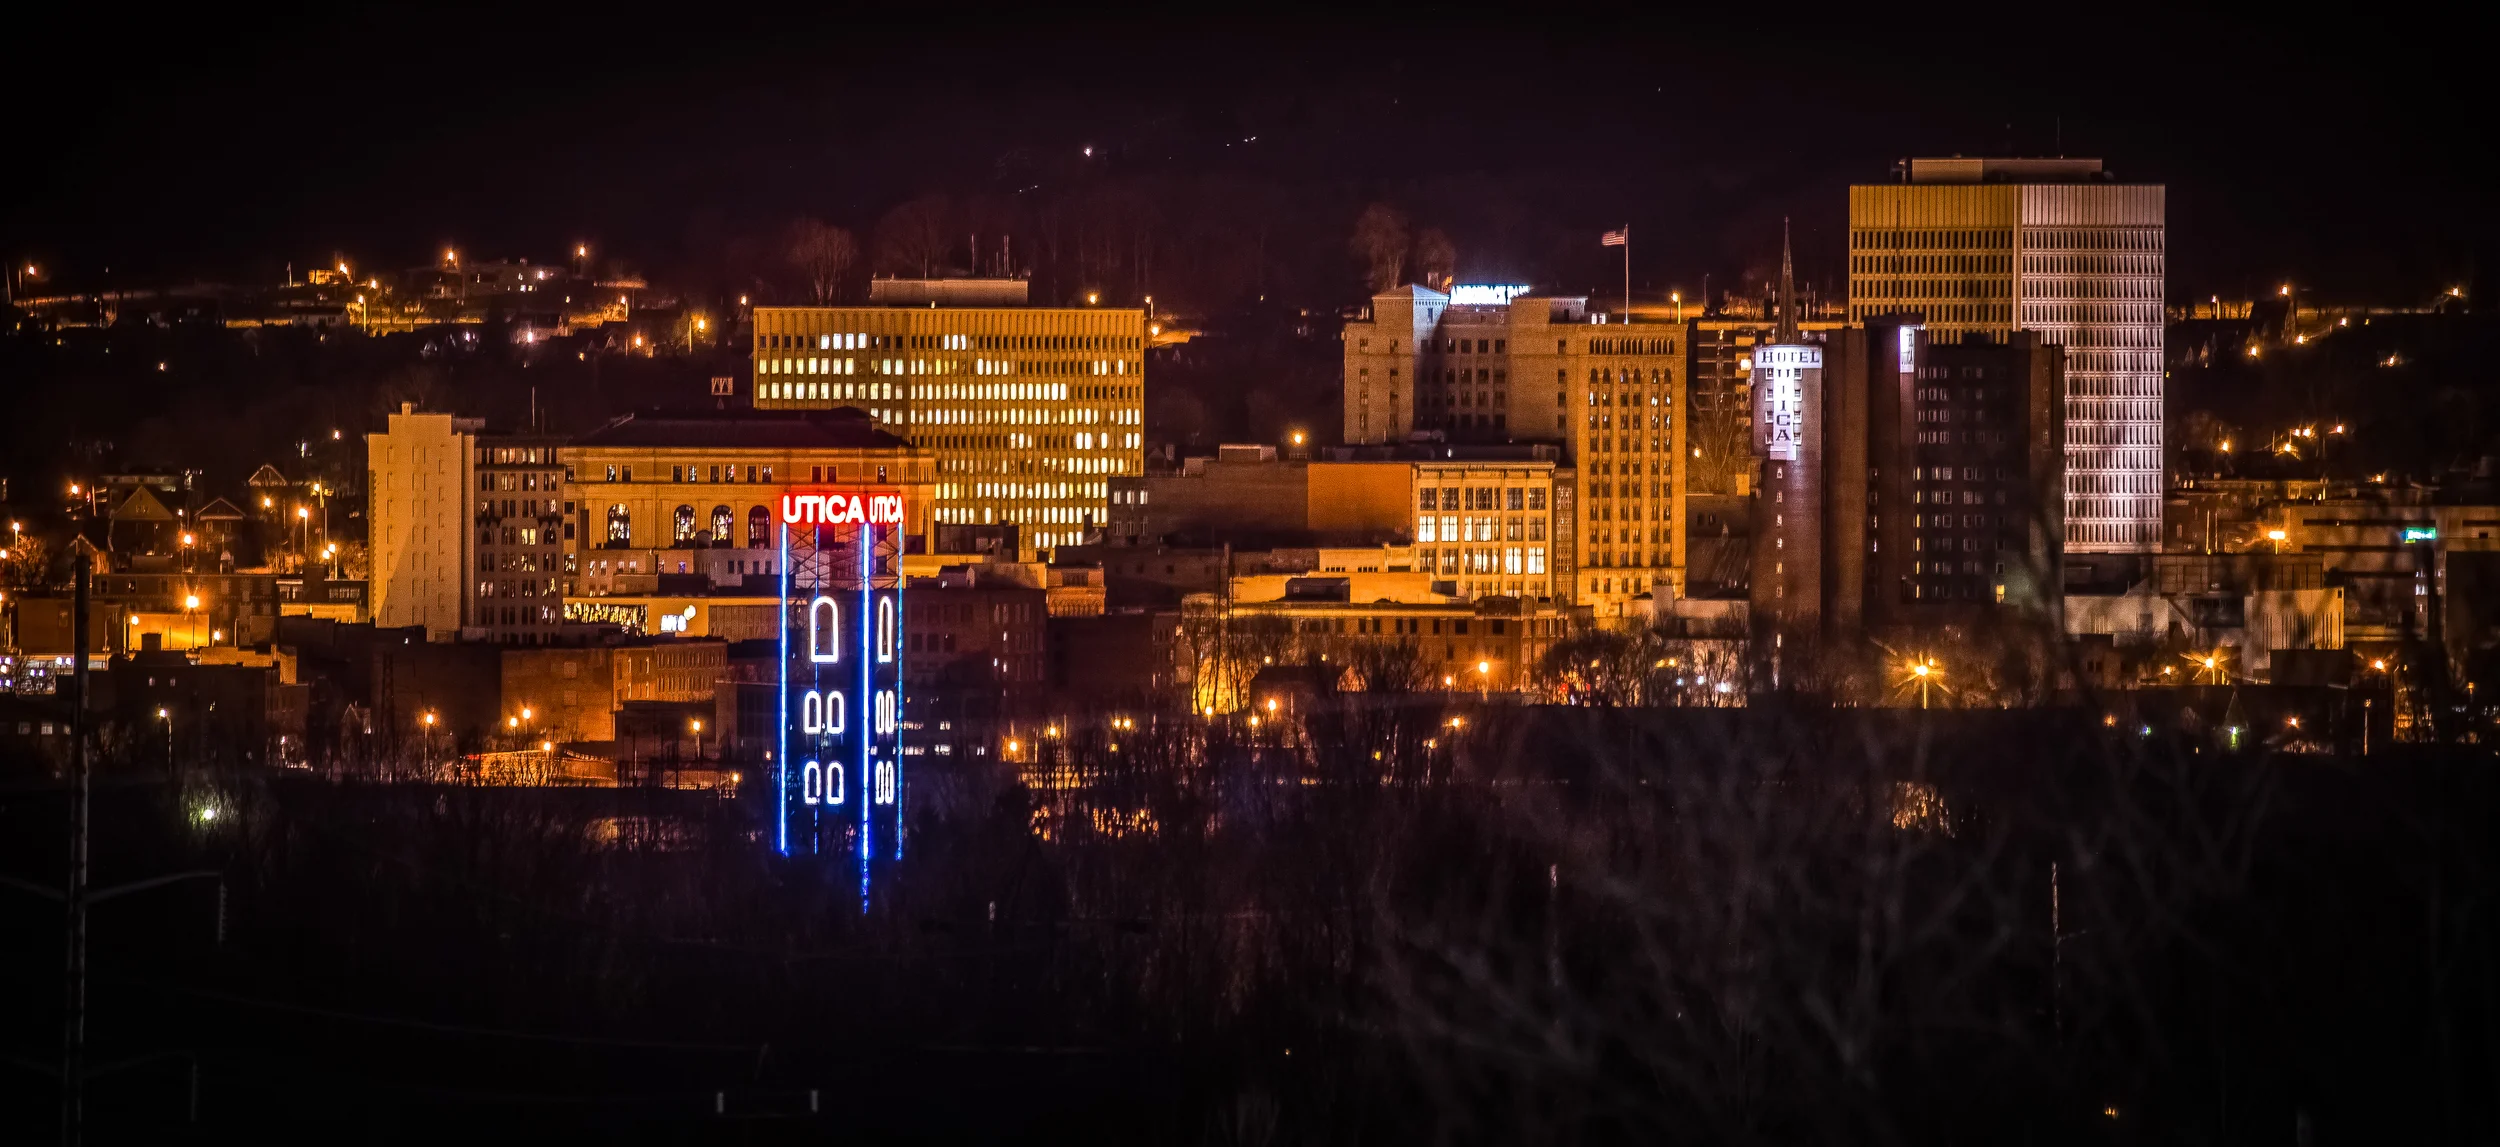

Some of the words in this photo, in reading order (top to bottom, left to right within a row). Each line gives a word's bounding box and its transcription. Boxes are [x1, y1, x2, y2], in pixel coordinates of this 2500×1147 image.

[1761, 351, 1820, 364] HOTEL
[782, 494, 866, 524] UTICA
[869, 495, 904, 524] UTICA
